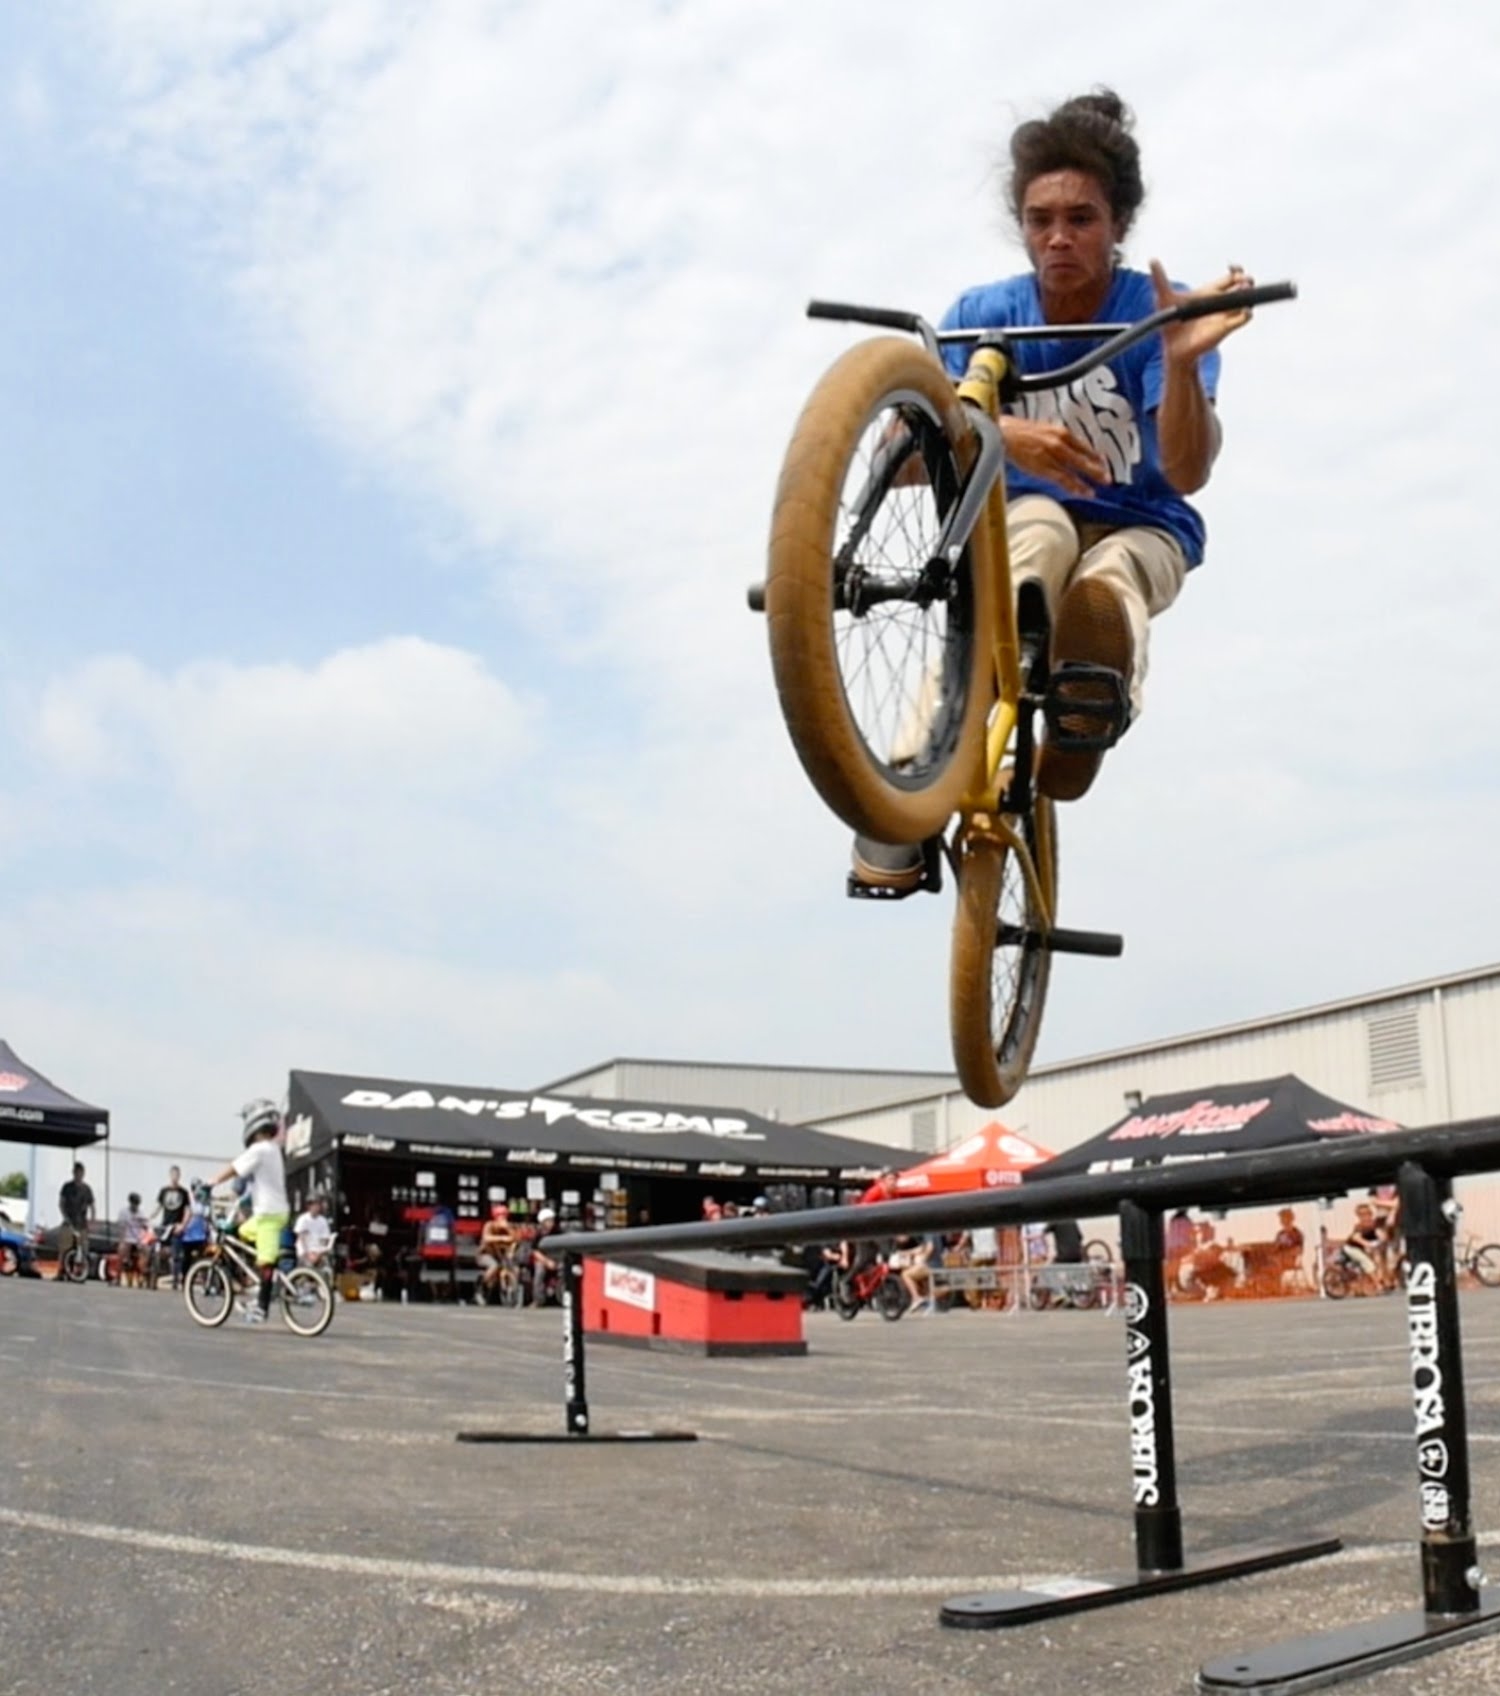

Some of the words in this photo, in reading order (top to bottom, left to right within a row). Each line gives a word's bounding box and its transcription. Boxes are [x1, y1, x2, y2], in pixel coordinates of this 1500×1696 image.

[340, 1089, 529, 1119] DAN'S
[574, 1109, 750, 1137] COMP
[1406, 1262, 1445, 1435] SUBROSA
[1128, 1356, 1158, 1505] SUBROSA
